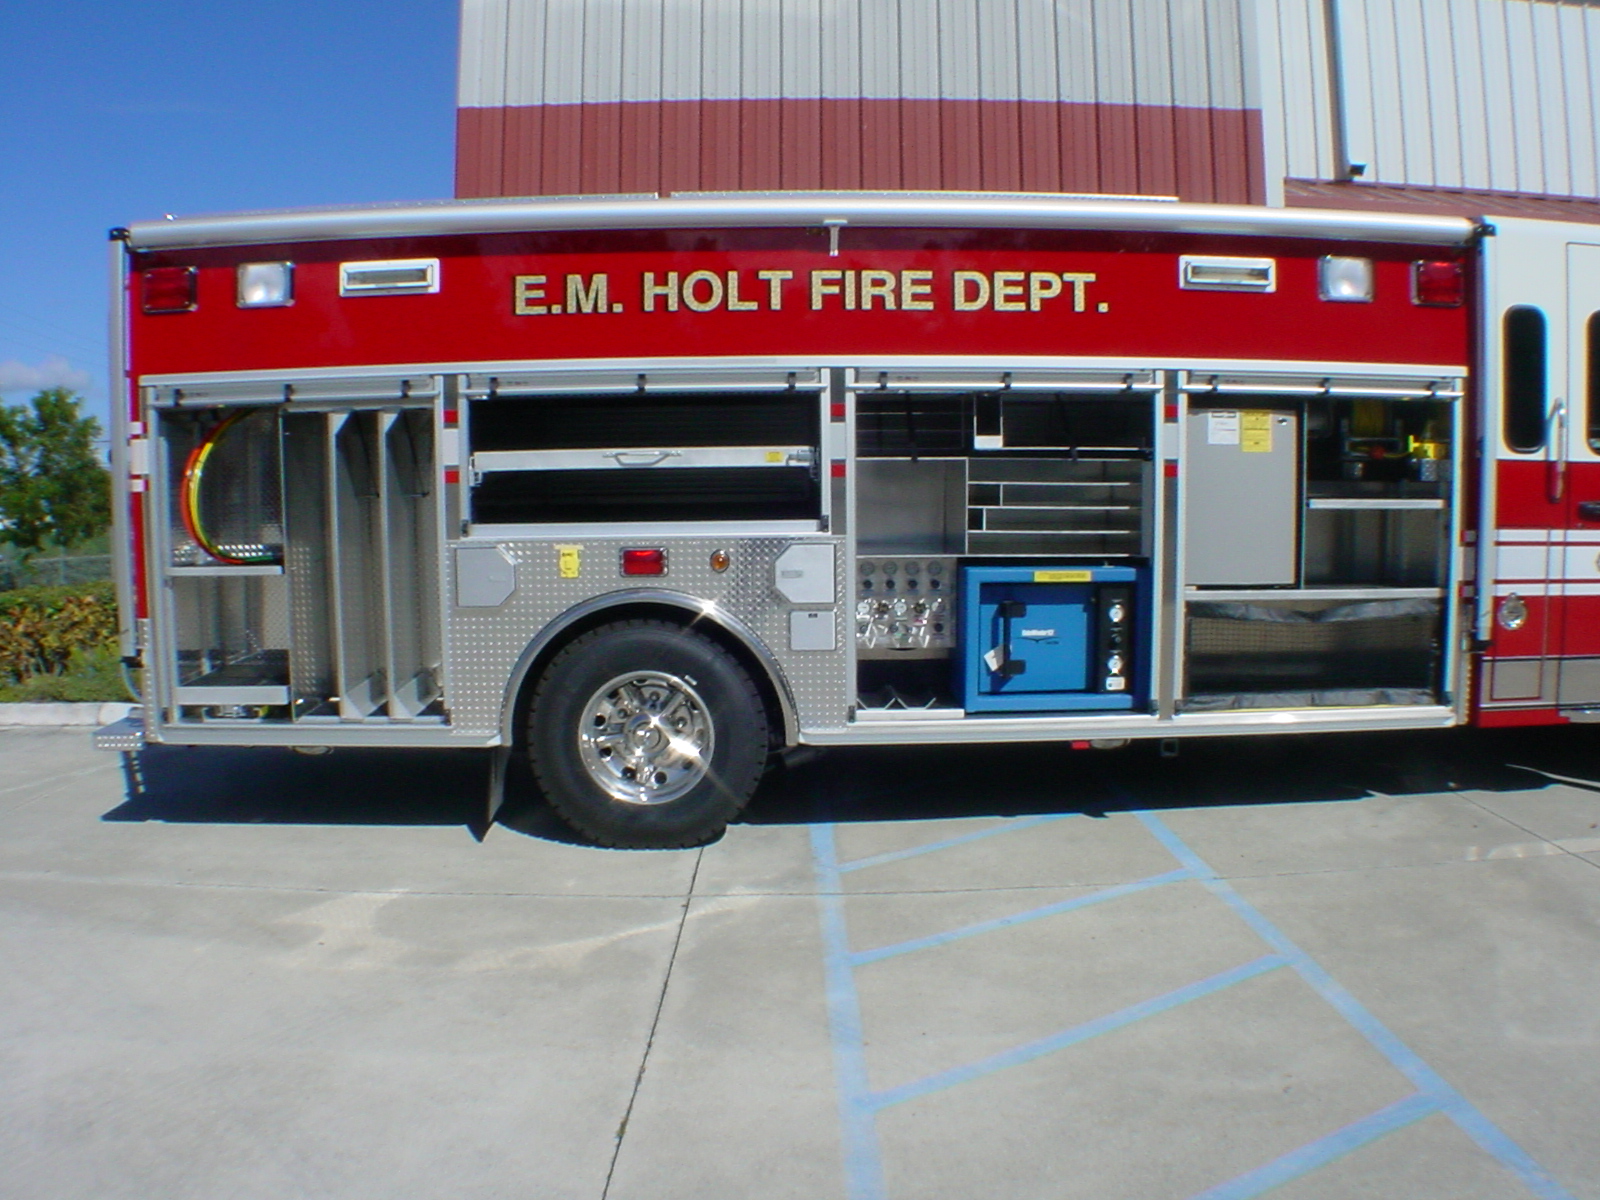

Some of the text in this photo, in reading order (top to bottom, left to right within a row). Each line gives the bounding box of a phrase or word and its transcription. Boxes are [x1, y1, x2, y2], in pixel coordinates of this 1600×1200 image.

[514, 269, 1109, 316] E.M. HOLT FIRE DEPT.
